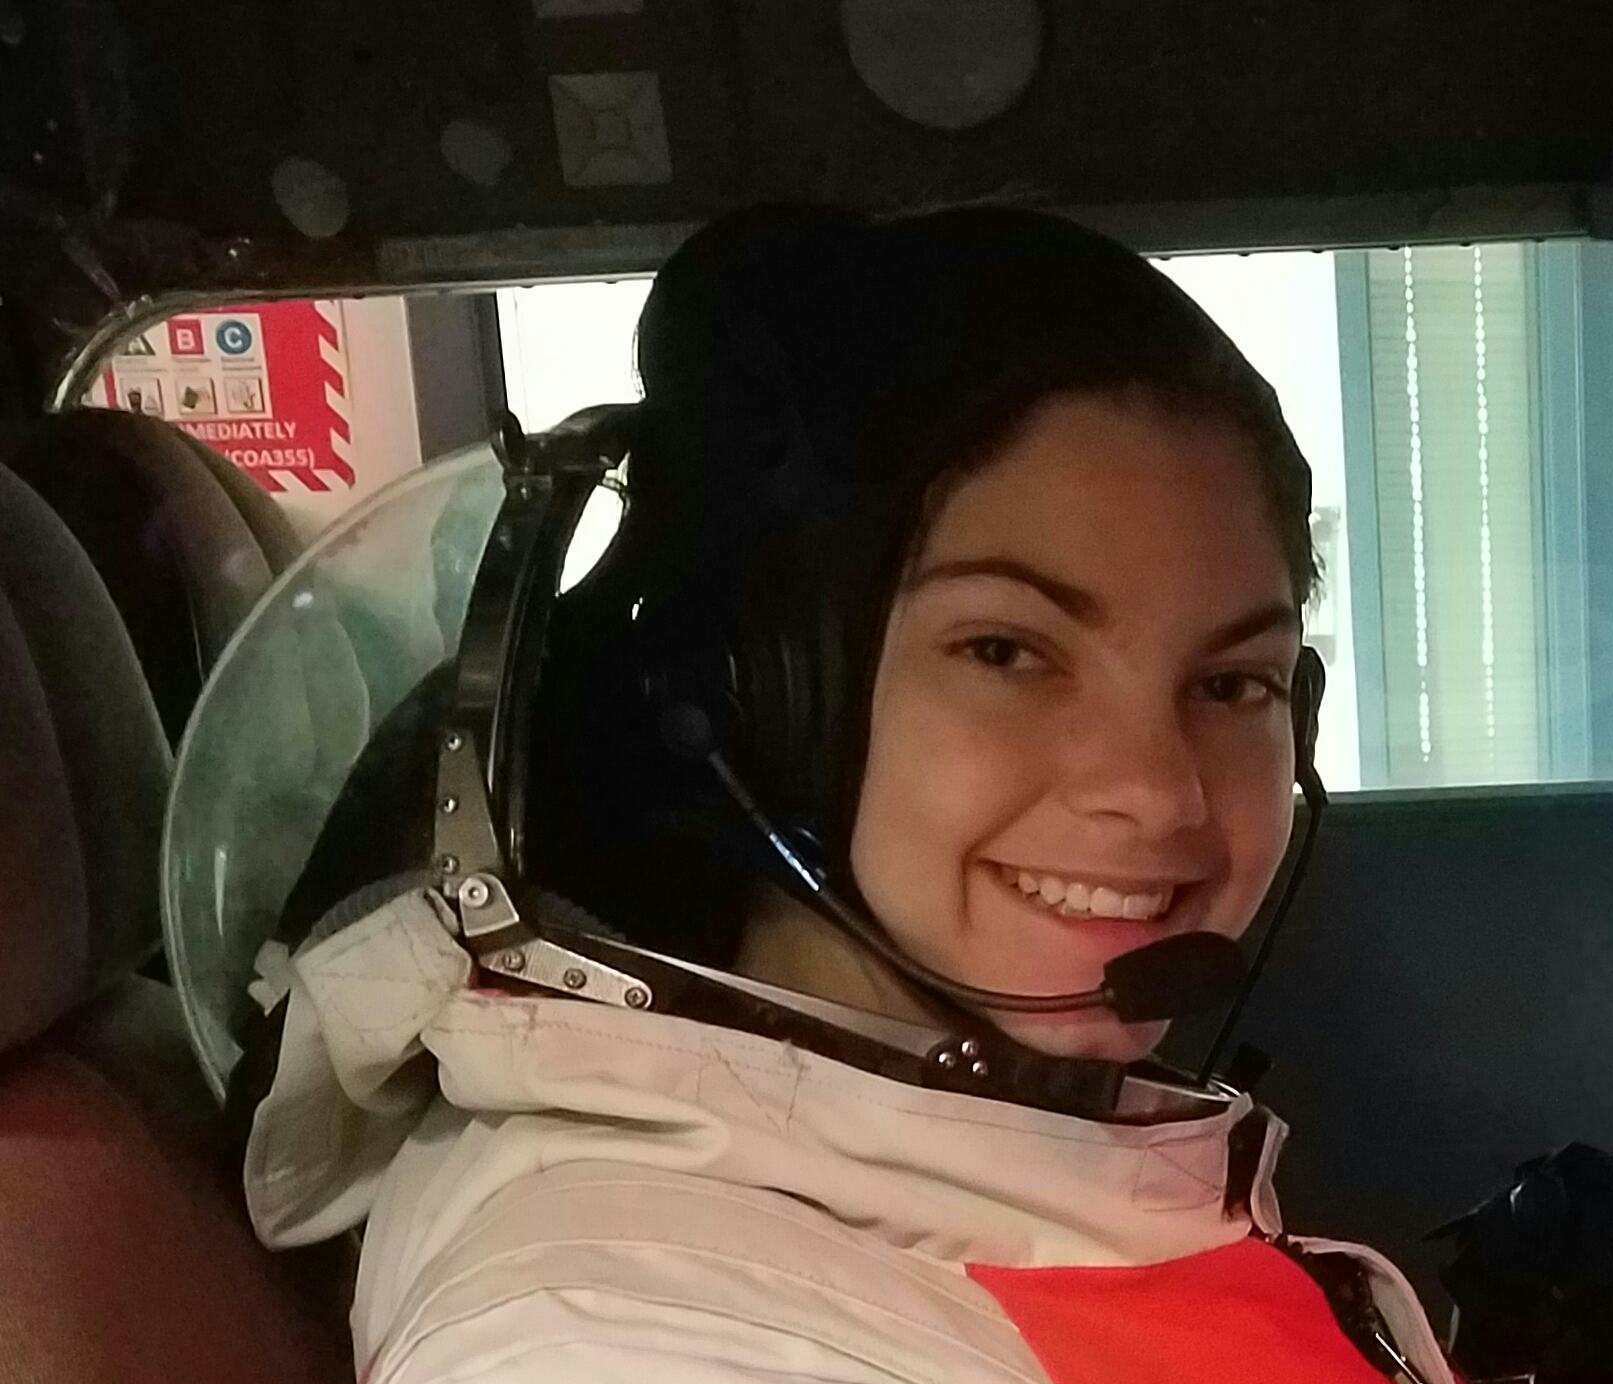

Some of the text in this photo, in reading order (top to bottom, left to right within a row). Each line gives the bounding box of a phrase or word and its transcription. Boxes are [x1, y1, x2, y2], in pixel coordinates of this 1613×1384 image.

[175, 328, 195, 350] B
[224, 326, 243, 348] C
[180, 421, 297, 441] MEDIATELY
